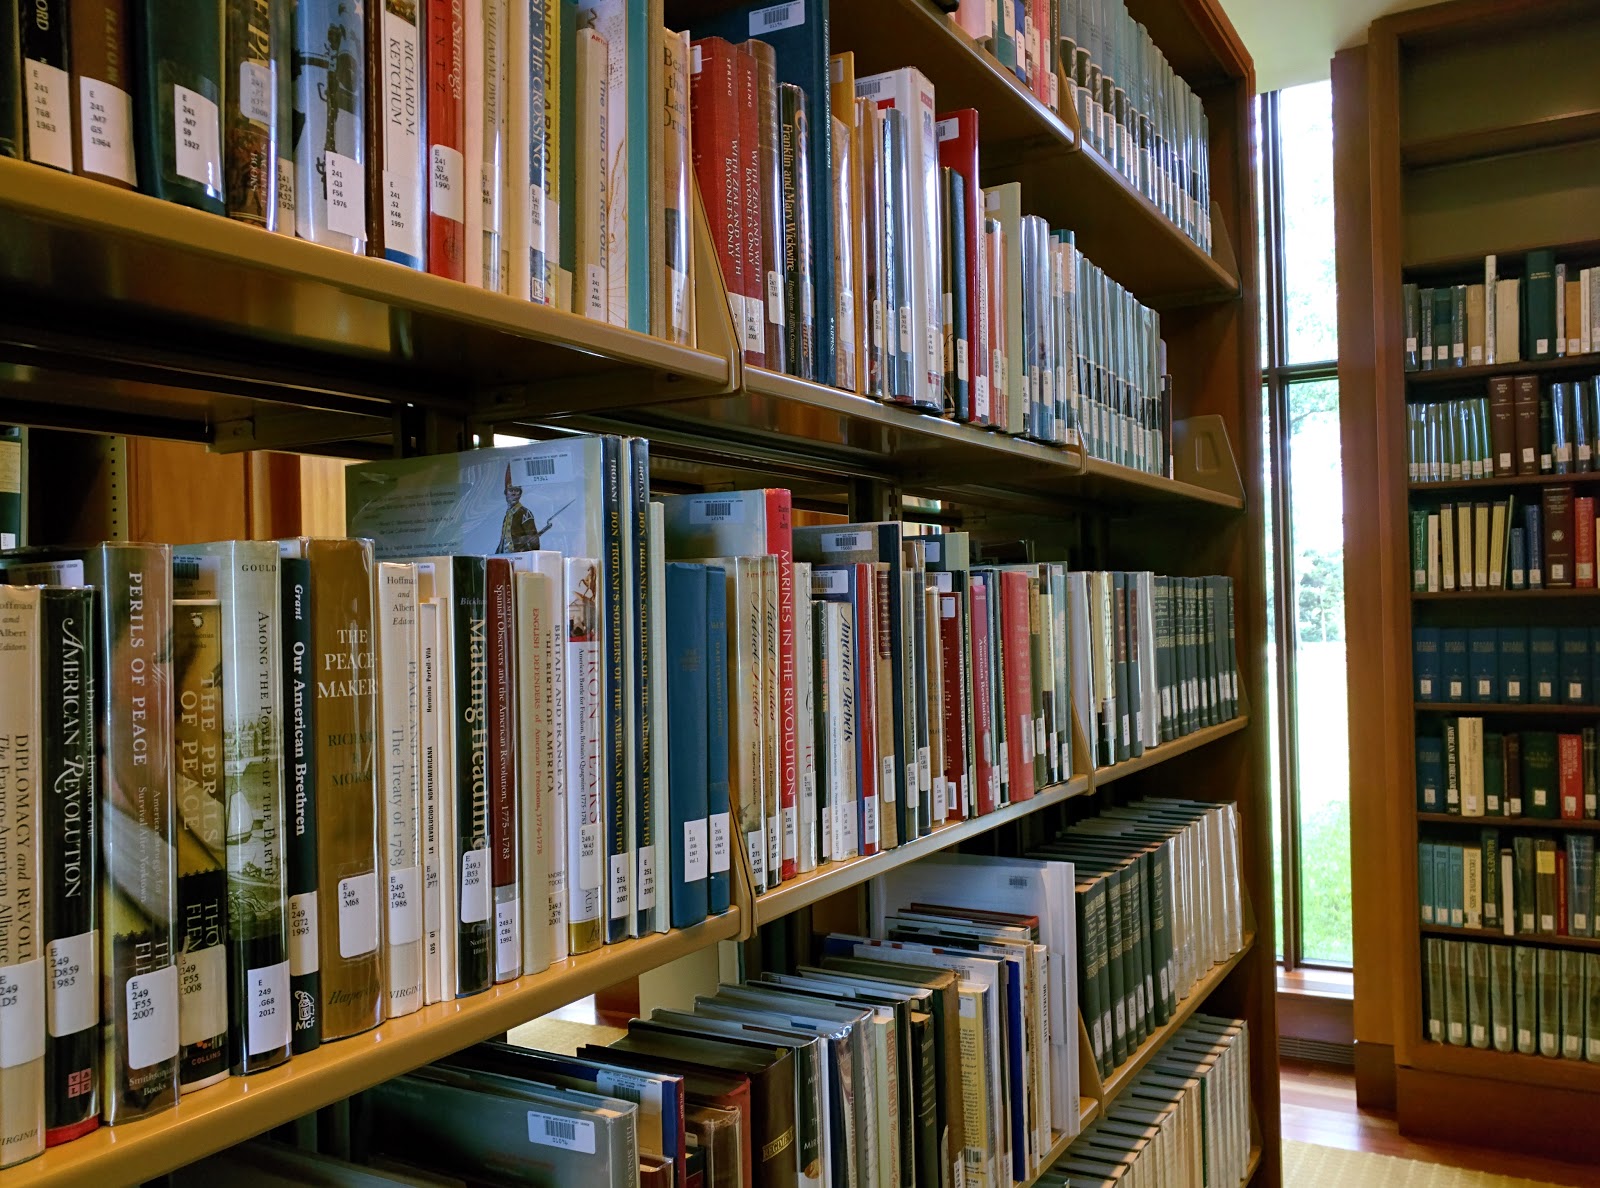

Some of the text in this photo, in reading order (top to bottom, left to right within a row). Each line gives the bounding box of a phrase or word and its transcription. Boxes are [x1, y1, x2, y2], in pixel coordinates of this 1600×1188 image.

[448, 22, 463, 100] Saratoga
[389, 38, 402, 125] KETCHUM
[404, 39, 416, 136] RICHARD M.
[90, 102, 105, 113] 241
[532, 33, 544, 169] THE CROSSING
[182, 105, 195, 116] 241
[91, 136, 111, 149] 1964
[183, 138, 200, 151] 1927
[434, 157, 446, 166] 241
[277, 174, 290, 183] 241
[331, 169, 343, 178] 241
[434, 173, 449, 182] M56
[390, 191, 401, 199] 241
[725, 158, 734, 219] BAYONETS
[332, 199, 348, 209] 1976
[782, 124, 797, 271] Franklin and Mary Wickwire
[745, 167, 755, 266] BAYONETS ONLY
[611, 511, 619, 536] DON
[242, 564, 277, 573] GOULD
[611, 541, 620, 601] TROIANI'S
[494, 584, 504, 619] Spanish
[532, 608, 540, 649] ENGLISH
[613, 604, 621, 664] SOLDIERS
[258, 611, 270, 665] AMONG
[337, 629, 368, 645] THE
[497, 622, 506, 665] Observers
[128, 571, 147, 766] PERILS OF PEACE
[465, 617, 488, 723] Making
[498, 668, 506, 685] and
[614, 667, 621, 683] OF
[780, 550, 797, 796] MARINES IN THE REVOLUTION
[840, 606, 854, 743] America Rebels
[62, 617, 85, 746] AMERICAN
[260, 671, 269, 700] THE
[533, 654, 541, 710] DEFENDERS
[293, 584, 308, 837] Grant Our American Brethren
[499, 704, 507, 747] American
[615, 715, 623, 777] AMERICAN
[180, 691, 200, 831] OF PEACE
[200, 671, 218, 843] THE PERILS
[500, 750, 509, 803] Revolution,
[389, 725, 405, 867] The Treaty of 1783
[138, 786, 148, 826] Survival
[263, 795, 272, 822] THE
[54, 754, 85, 898] REVOLUTION
[15, 734, 31, 961] DIPLOMACY and REVOLU
[264, 828, 276, 878] EARTH
[465, 862, 481, 870] 249.3
[426, 872, 437, 880] 249
[465, 878, 480, 886] 2009
[343, 890, 355, 899] 249
[390, 884, 404, 892] 249
[391, 892, 405, 900] .P42
[343, 898, 359, 909] .M68
[291, 909, 305, 919] 249
[292, 918, 308, 928] .G72
[0, 904, 13, 964] Alliance
[292, 927, 310, 937] 1995
[500, 936, 512, 944] 1992
[51, 957, 69, 968] 249
[0, 985, 18, 995] 249
[52, 977, 76, 990] 1985
[131, 982, 138, 990] E
[258, 987, 272, 995] 249
[132, 989, 149, 1000] 249
[258, 997, 275, 1007] .G68
[132, 998, 152, 1011] .F55
[132, 1008, 155, 1020] 2007
[258, 1008, 275, 1018] 2012
[191, 1051, 222, 1065] COLLINS
[886, 1029, 897, 1118] BENEDICT ARNOLD
[143, 1082, 167, 1096] Books
